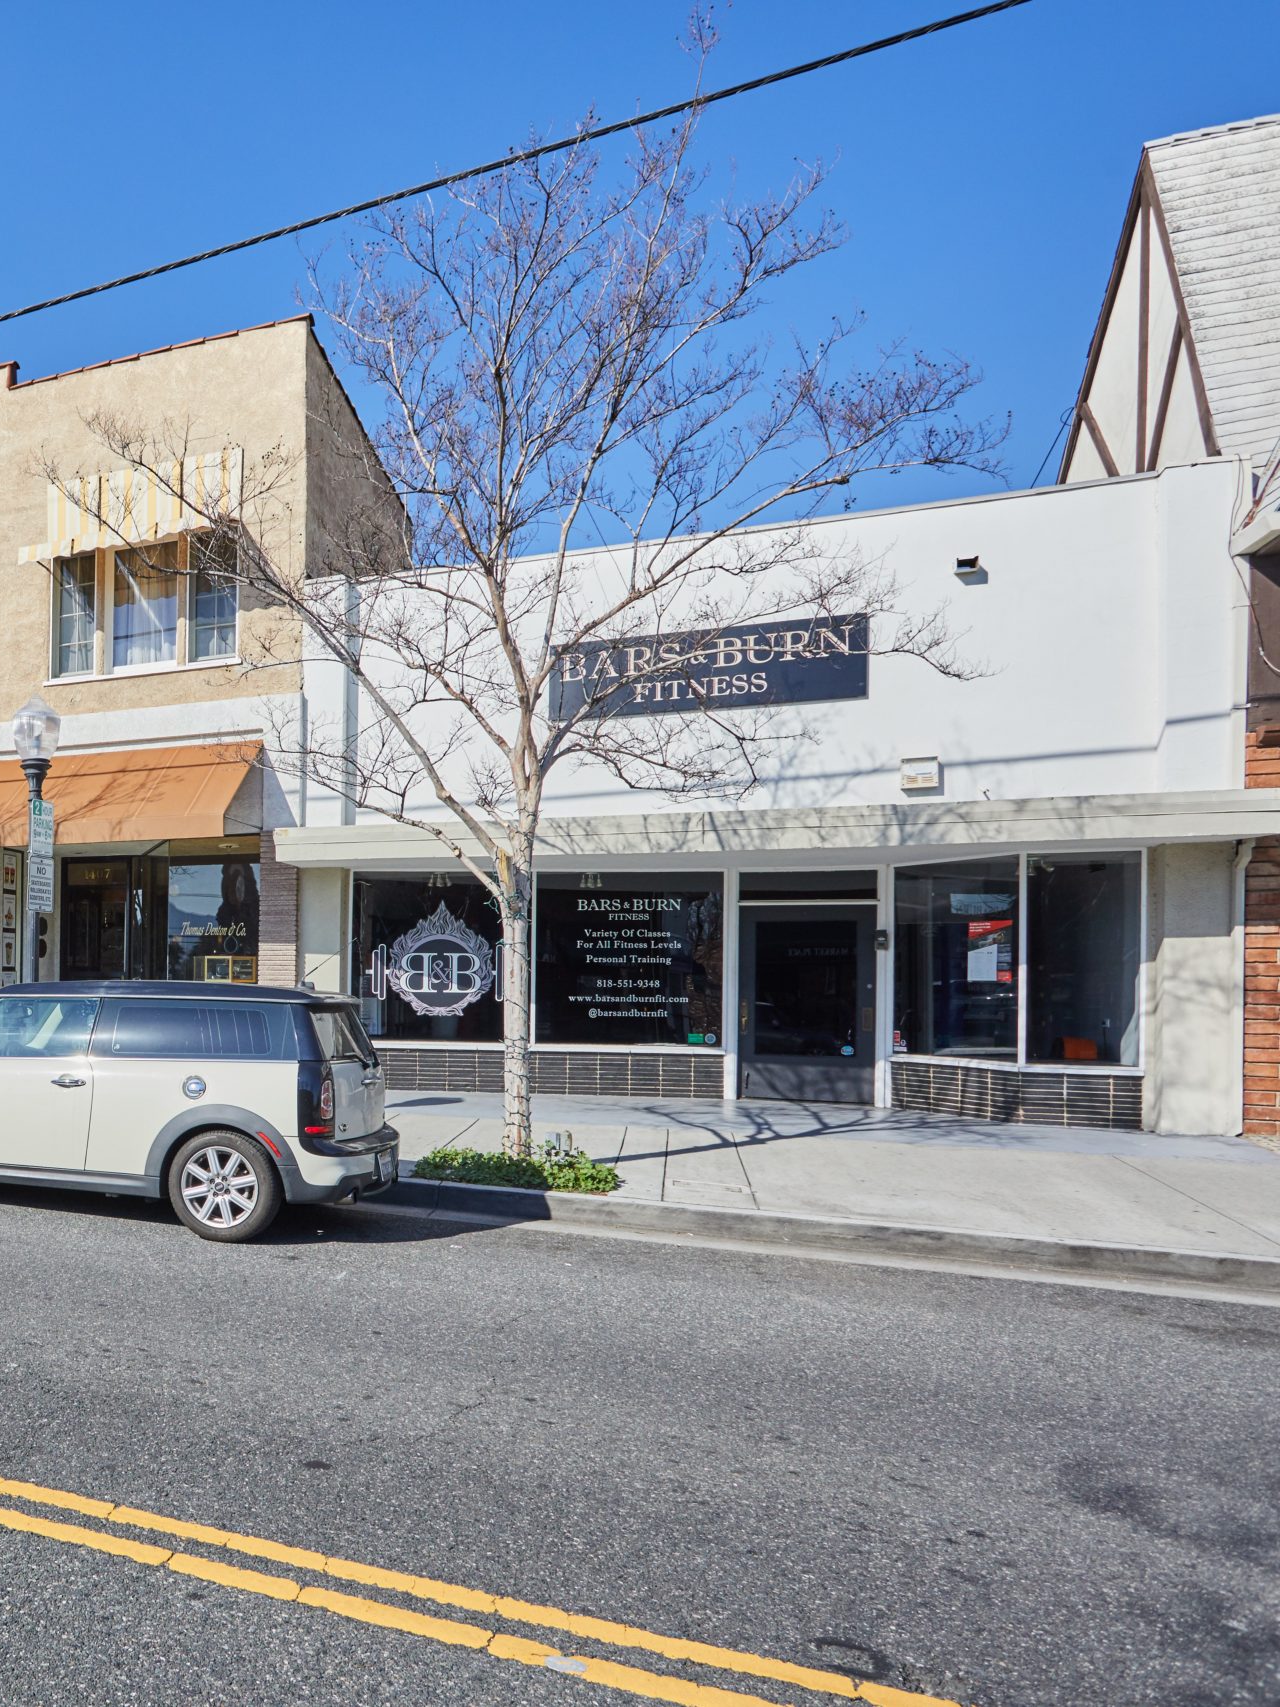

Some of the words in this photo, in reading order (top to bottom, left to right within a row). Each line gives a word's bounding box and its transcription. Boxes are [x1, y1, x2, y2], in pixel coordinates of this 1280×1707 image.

[560, 642, 682, 682] BARS
[690, 650, 709, 665] &
[713, 625, 855, 668] BURN
[633, 672, 768, 703] FITNESS
[35, 801, 40, 815] 2
[34, 817, 53, 831] PARKING
[36, 866, 47, 876] NO
[577, 898, 622, 911] BARS
[623, 901, 631, 909] &
[633, 898, 682, 911] BURN
[608, 913, 650, 921] FITNESS
[181, 921, 205, 936] Thomas
[205, 922, 228, 936] Denton
[228, 922, 236, 936] &
[236, 922, 247, 937] Co.
[584, 929, 619, 938] Variety
[621, 929, 633, 937] Of
[635, 929, 671, 938] Classes
[577, 940, 593, 949] For
[595, 940, 611, 949] All
[614, 940, 646, 949] Fitness
[648, 940, 682, 949] Levels
[586, 954, 627, 964] Personal
[629, 954, 672, 966] Training
[596, 978, 660, 988] 818-551-9348
[568, 993, 689, 1004] www.barsandburnfit.com
[588, 1007, 668, 1018] @barsandburnfit
